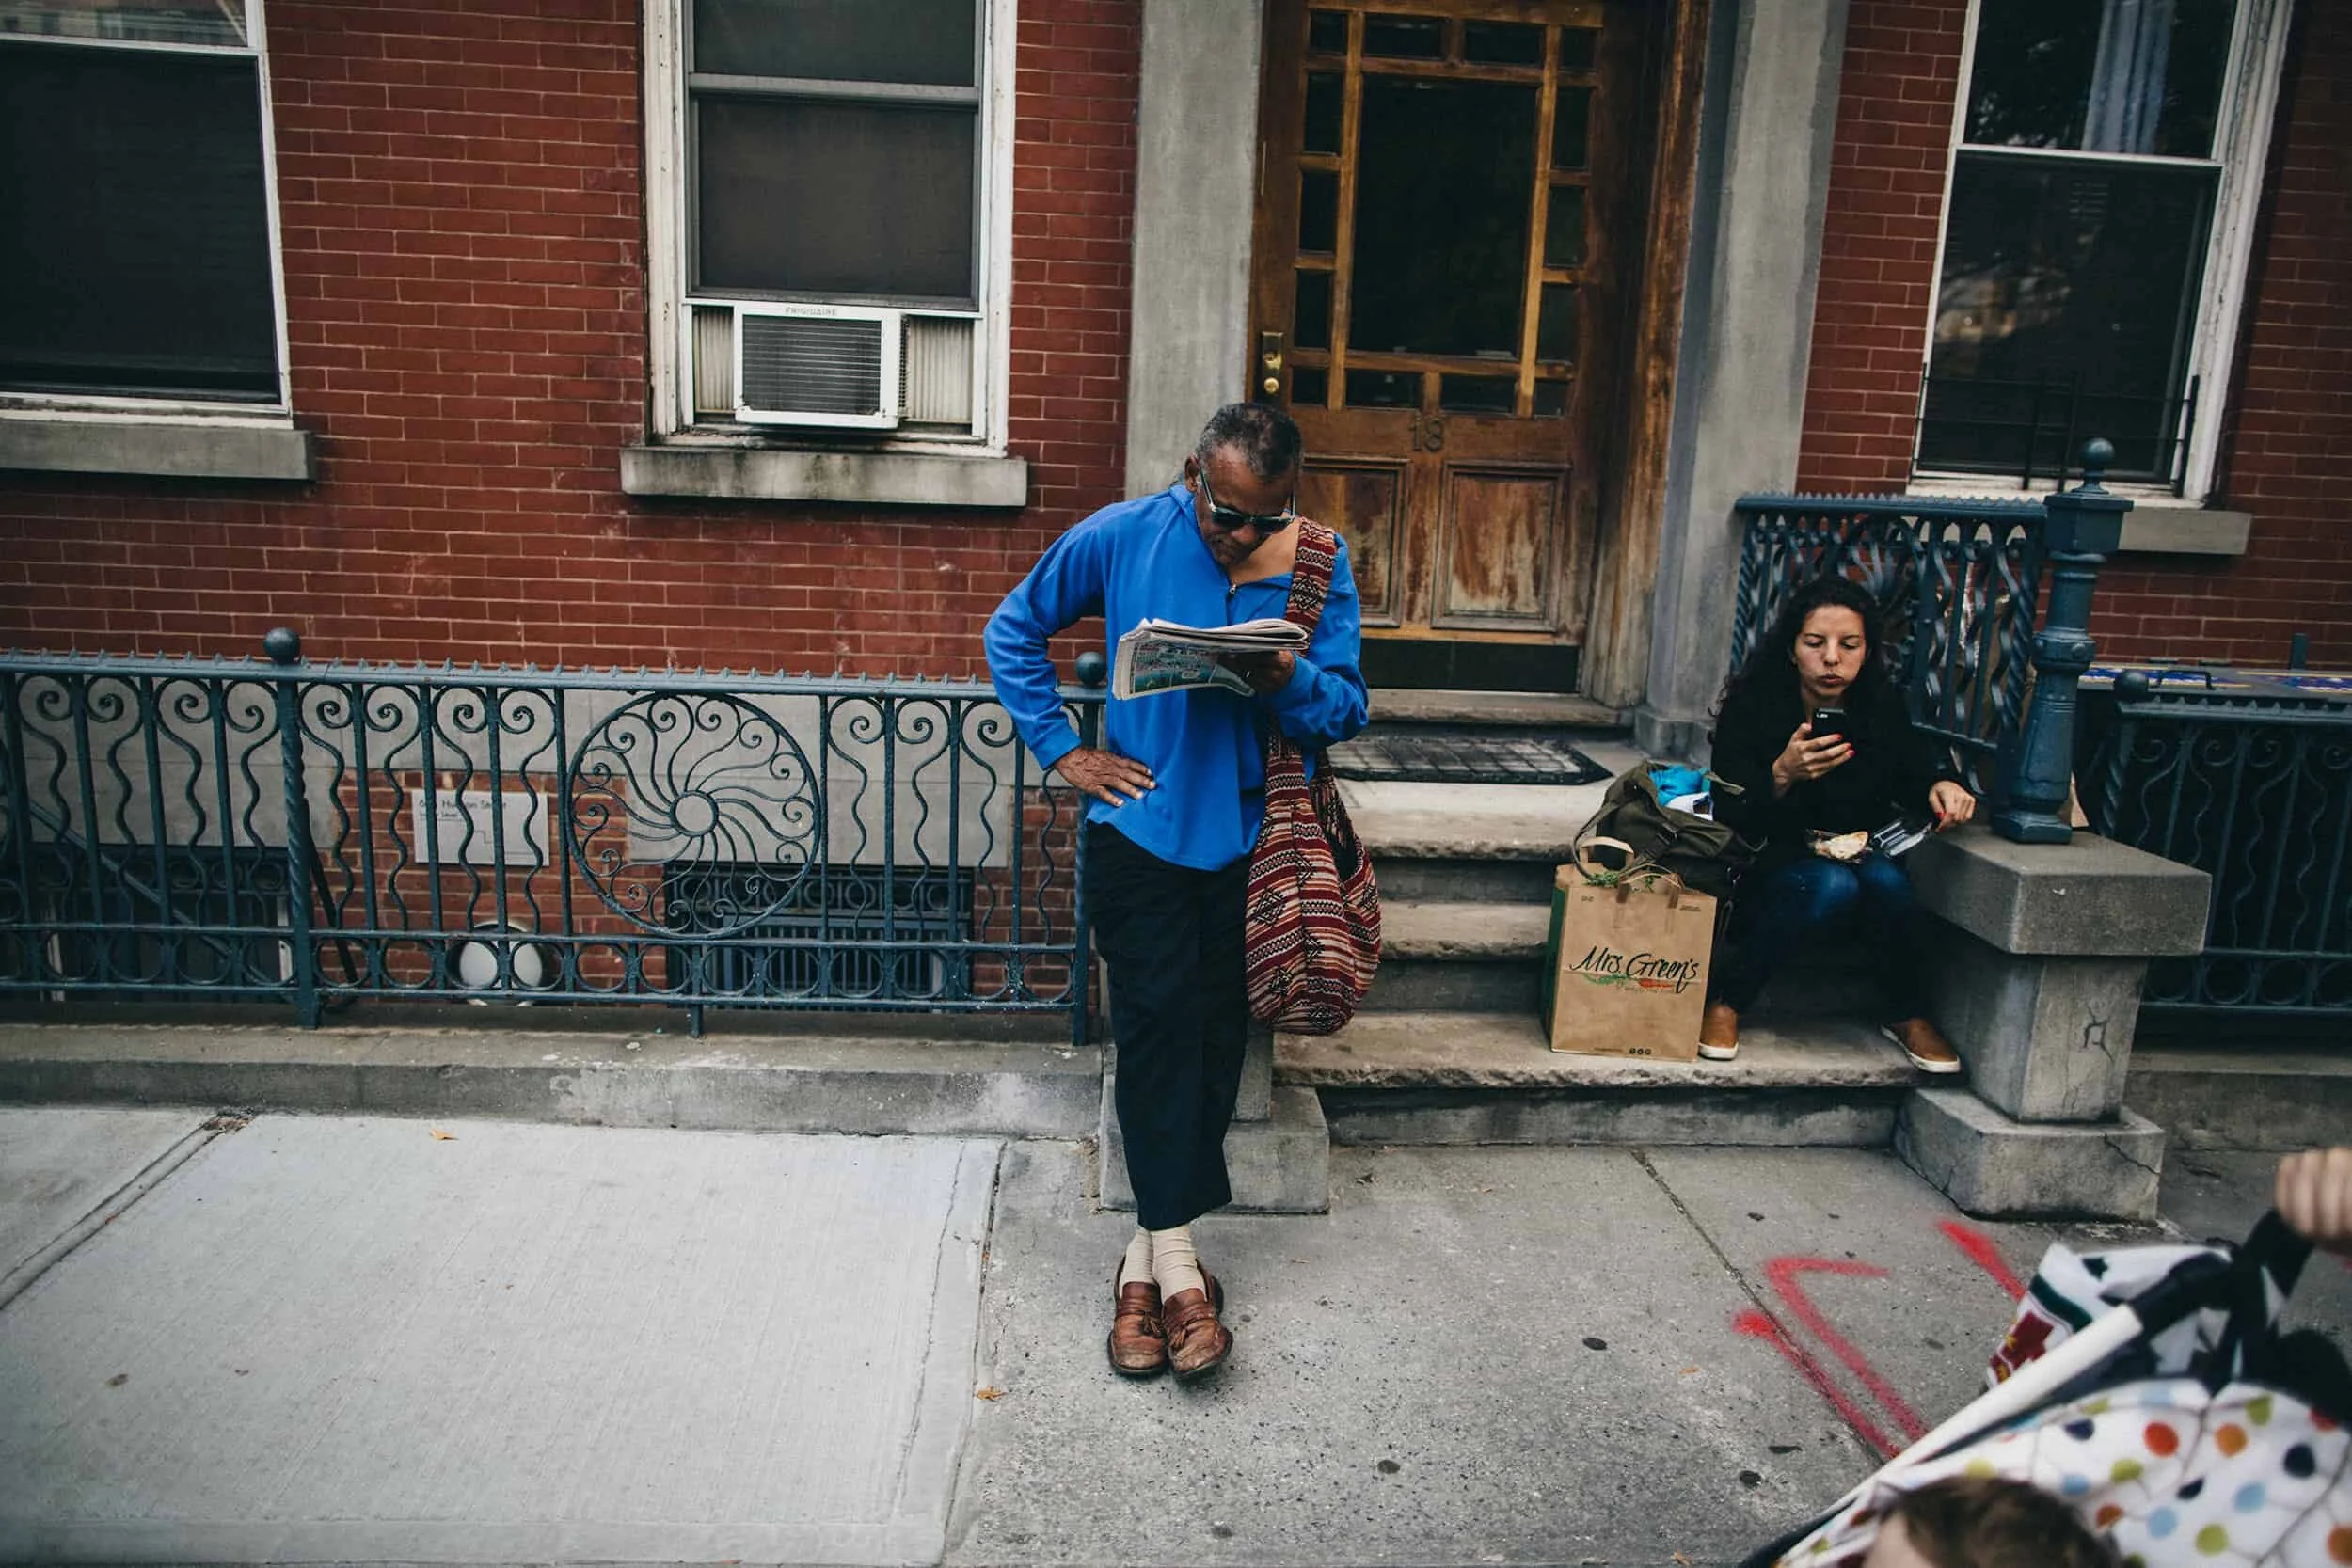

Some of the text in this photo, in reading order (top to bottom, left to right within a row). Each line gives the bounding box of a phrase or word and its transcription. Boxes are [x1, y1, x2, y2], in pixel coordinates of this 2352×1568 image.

[785, 307, 837, 317] FRIGIDAIRE
[1569, 945, 1699, 994] Mrs. Green's
